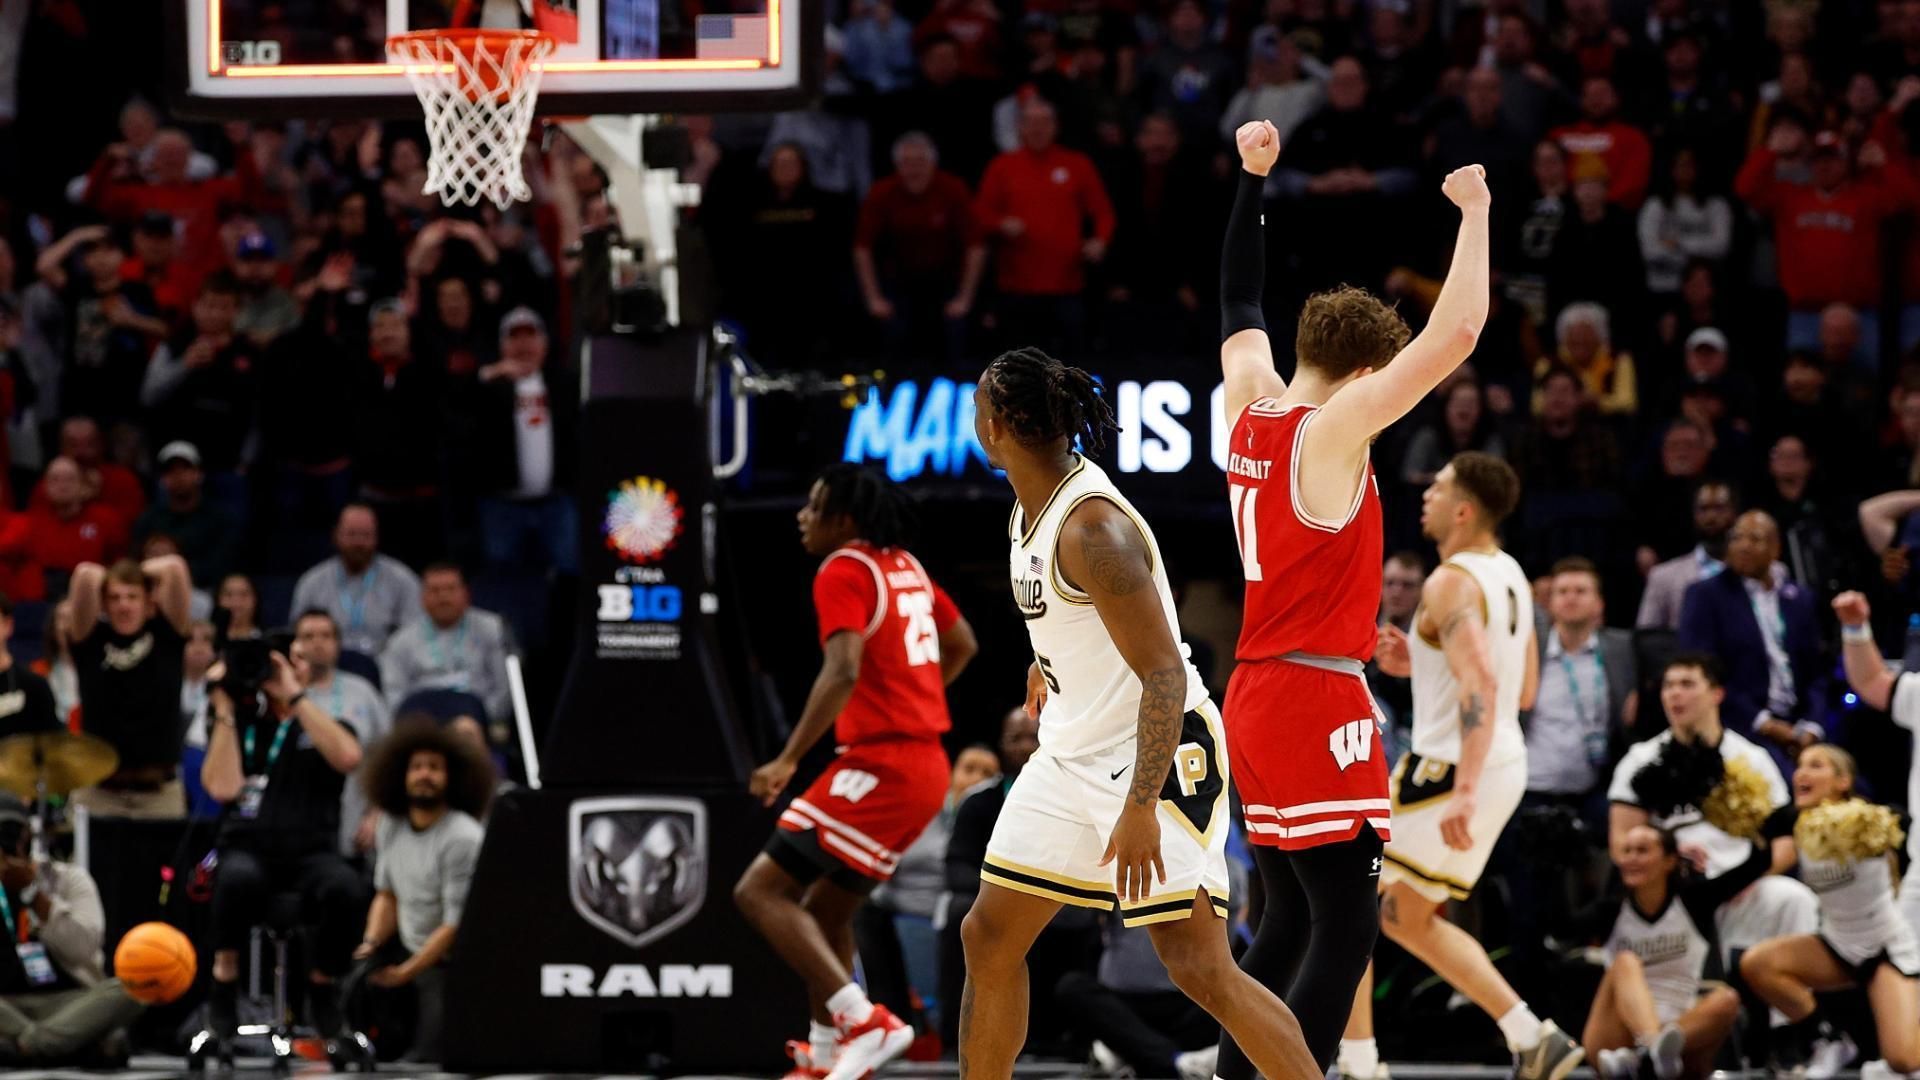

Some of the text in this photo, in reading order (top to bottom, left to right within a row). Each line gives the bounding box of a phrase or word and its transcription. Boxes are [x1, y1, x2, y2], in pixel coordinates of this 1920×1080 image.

[1117, 380, 1192, 473] IS
[896, 590, 940, 667] 25
[1173, 742, 1208, 797] P
[1328, 718, 1375, 773] W
[828, 768, 880, 805] W
[541, 964, 734, 997] RAM
